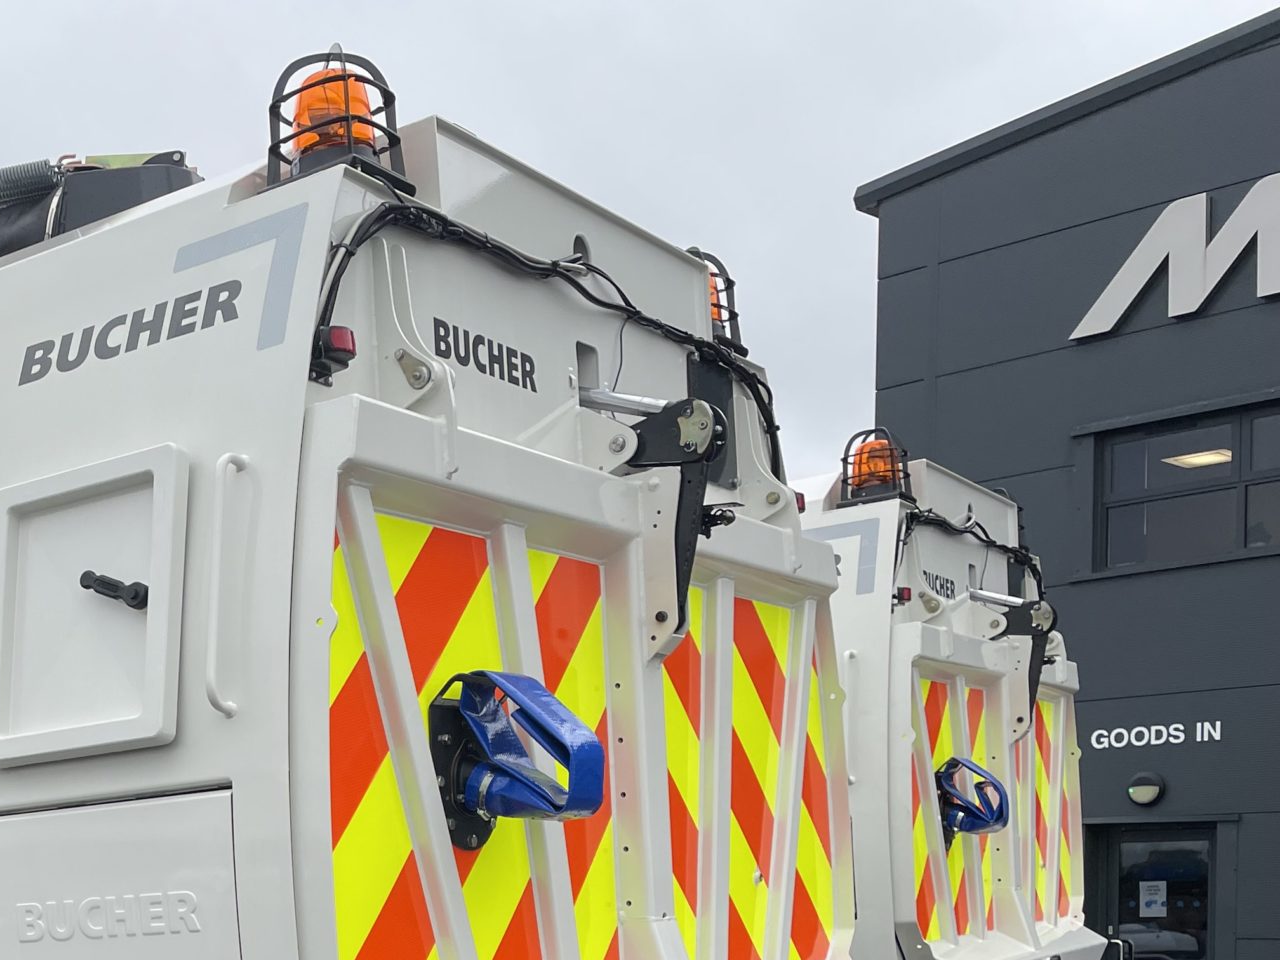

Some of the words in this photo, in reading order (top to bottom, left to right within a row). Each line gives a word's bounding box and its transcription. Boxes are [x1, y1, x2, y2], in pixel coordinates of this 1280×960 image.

[18, 279, 242, 386] BUCHER
[433, 316, 538, 393] BUCHER
[1090, 723, 1186, 750] GOODS
[1195, 720, 1222, 742] IN
[16, 890, 201, 943] BUCHER
